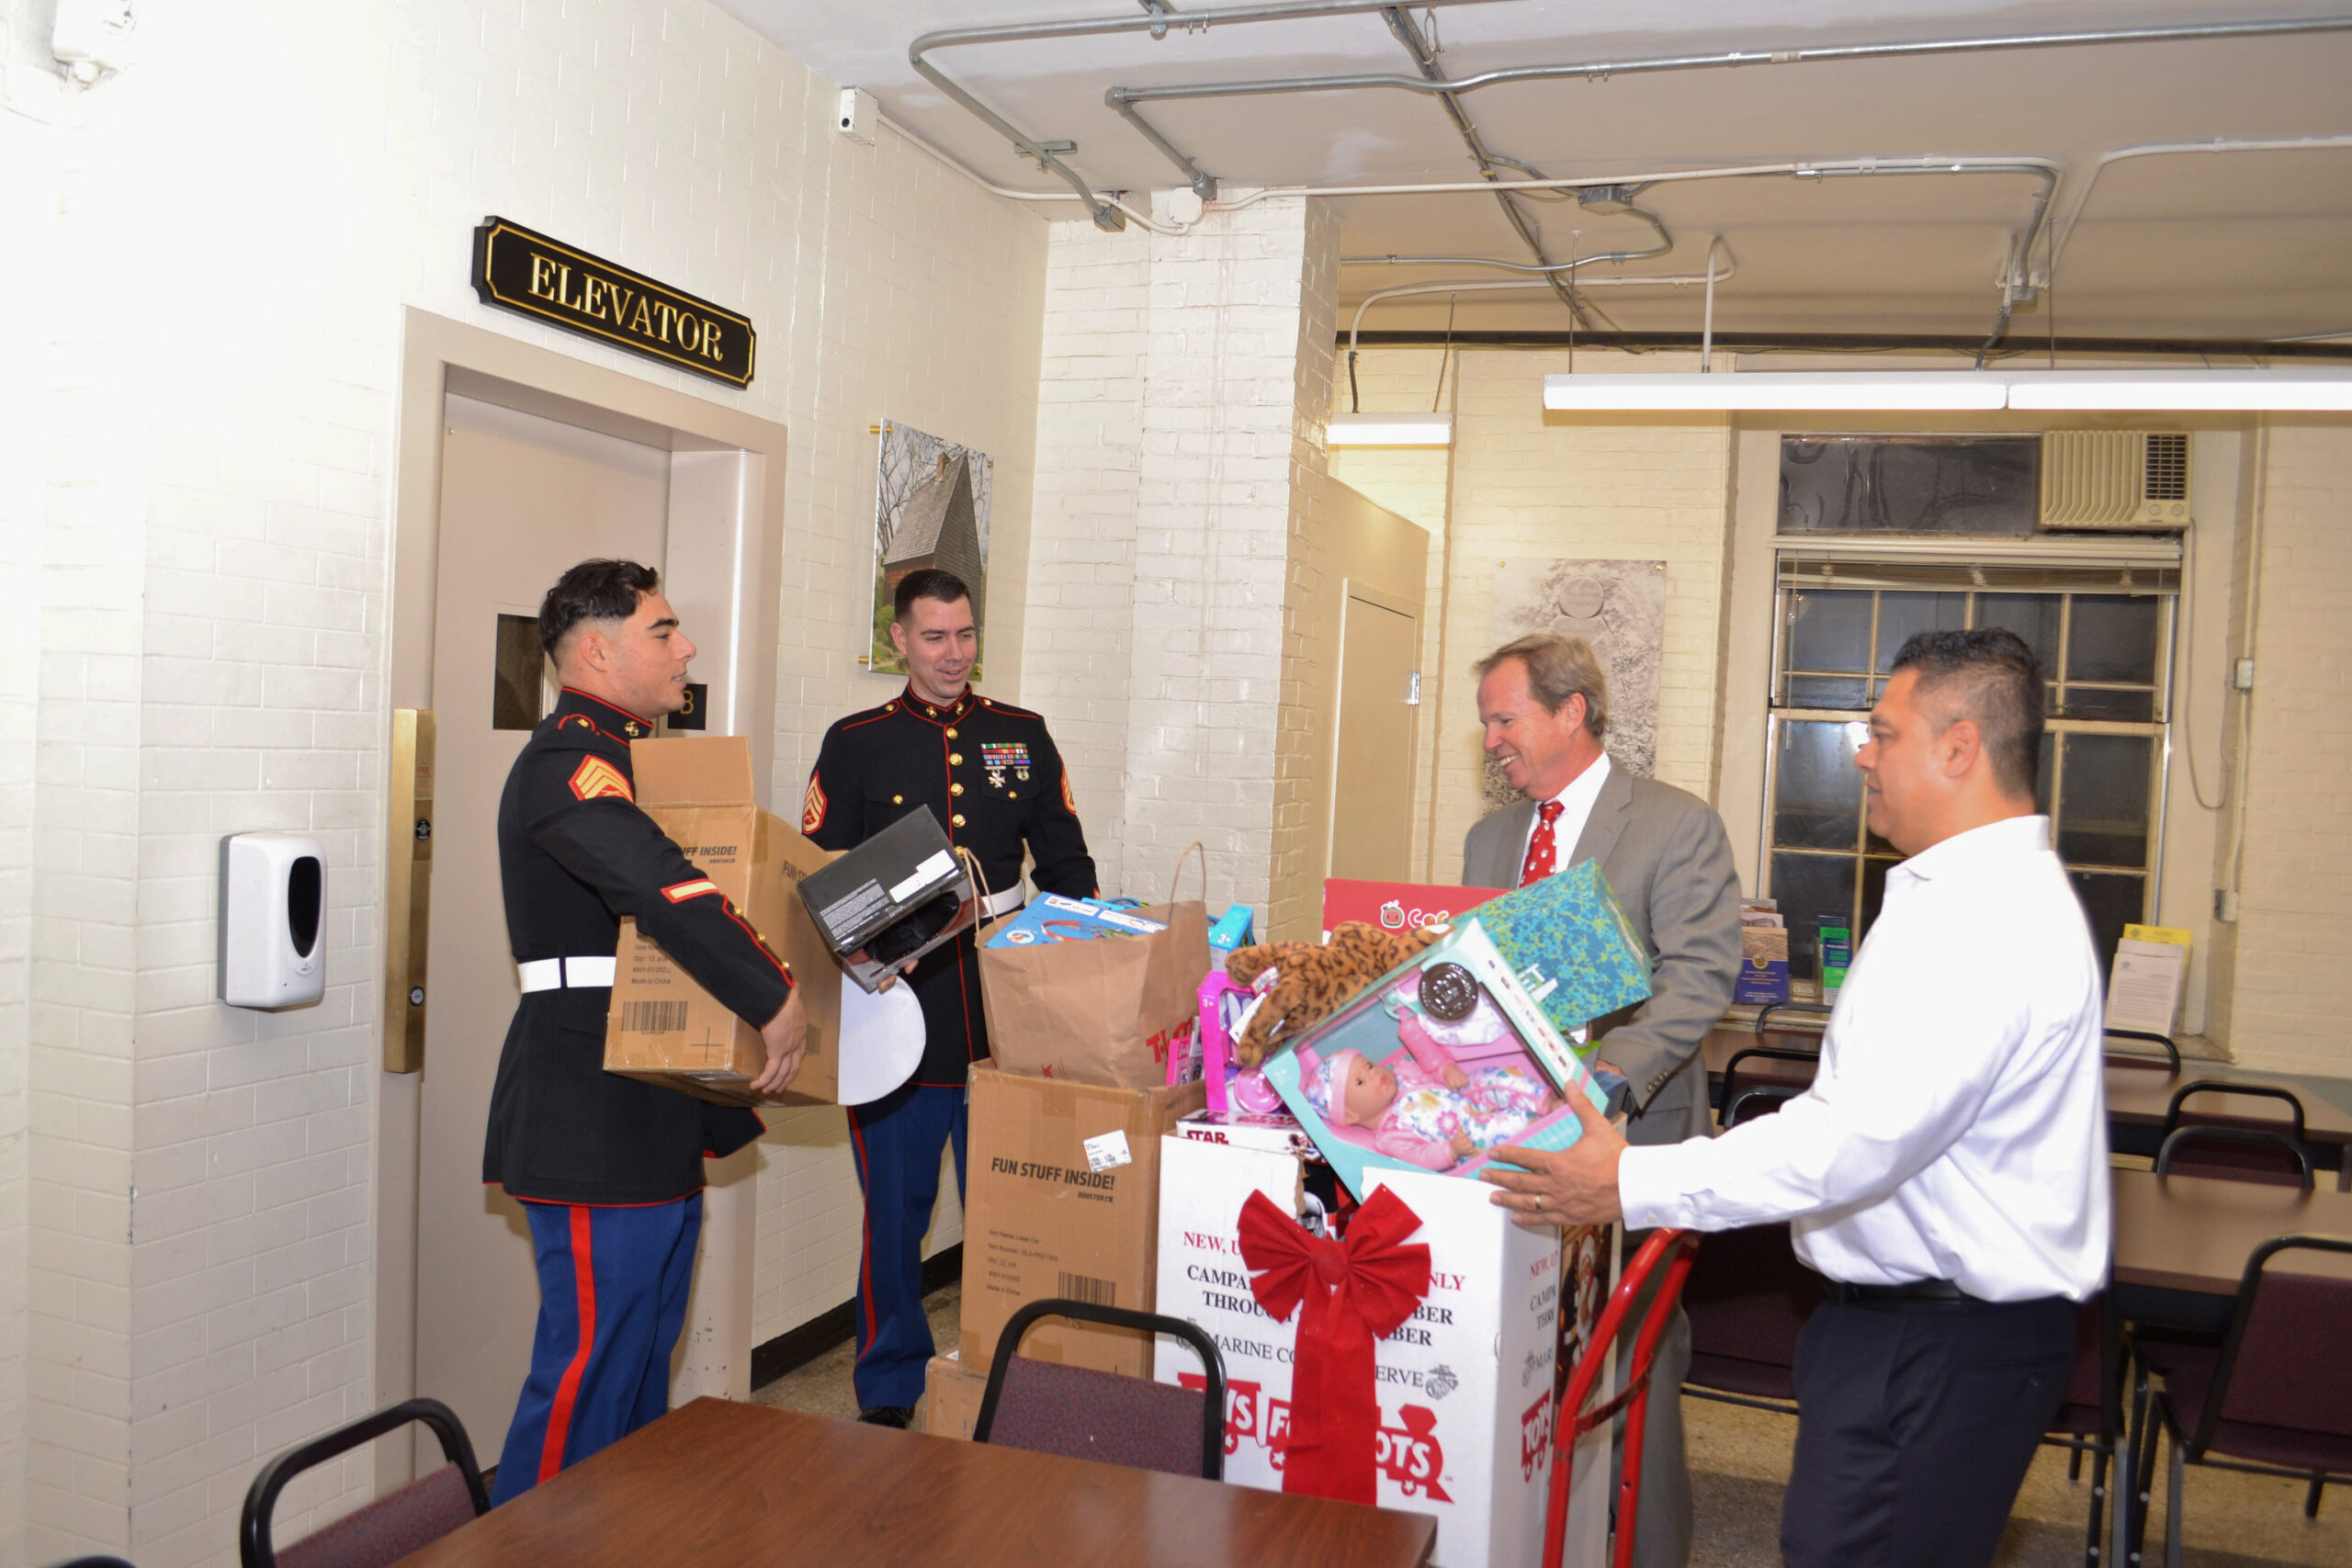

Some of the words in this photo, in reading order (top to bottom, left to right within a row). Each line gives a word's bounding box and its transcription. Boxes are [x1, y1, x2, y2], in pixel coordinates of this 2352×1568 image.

[527, 252, 723, 362] ELEVATOR
[699, 846, 737, 855] INSIDE!
[1186, 1130, 1229, 1145] STAR
[991, 1157, 1018, 1175] FUN
[1020, 1162, 1062, 1181] STUFF
[1064, 1168, 1115, 1190] INSIDE!
[1184, 1232, 1227, 1255] NEW,
[1187, 1264, 1250, 1291] CAMPA
[1429, 1272, 1465, 1292] NLY
[1203, 1291, 1293, 1323] THROU
[1414, 1305, 1454, 1325] BER
[1387, 1326, 1433, 1347] BER
[1375, 1365, 1424, 1388] ERVE
[1375, 1431, 1430, 1478] OTS
